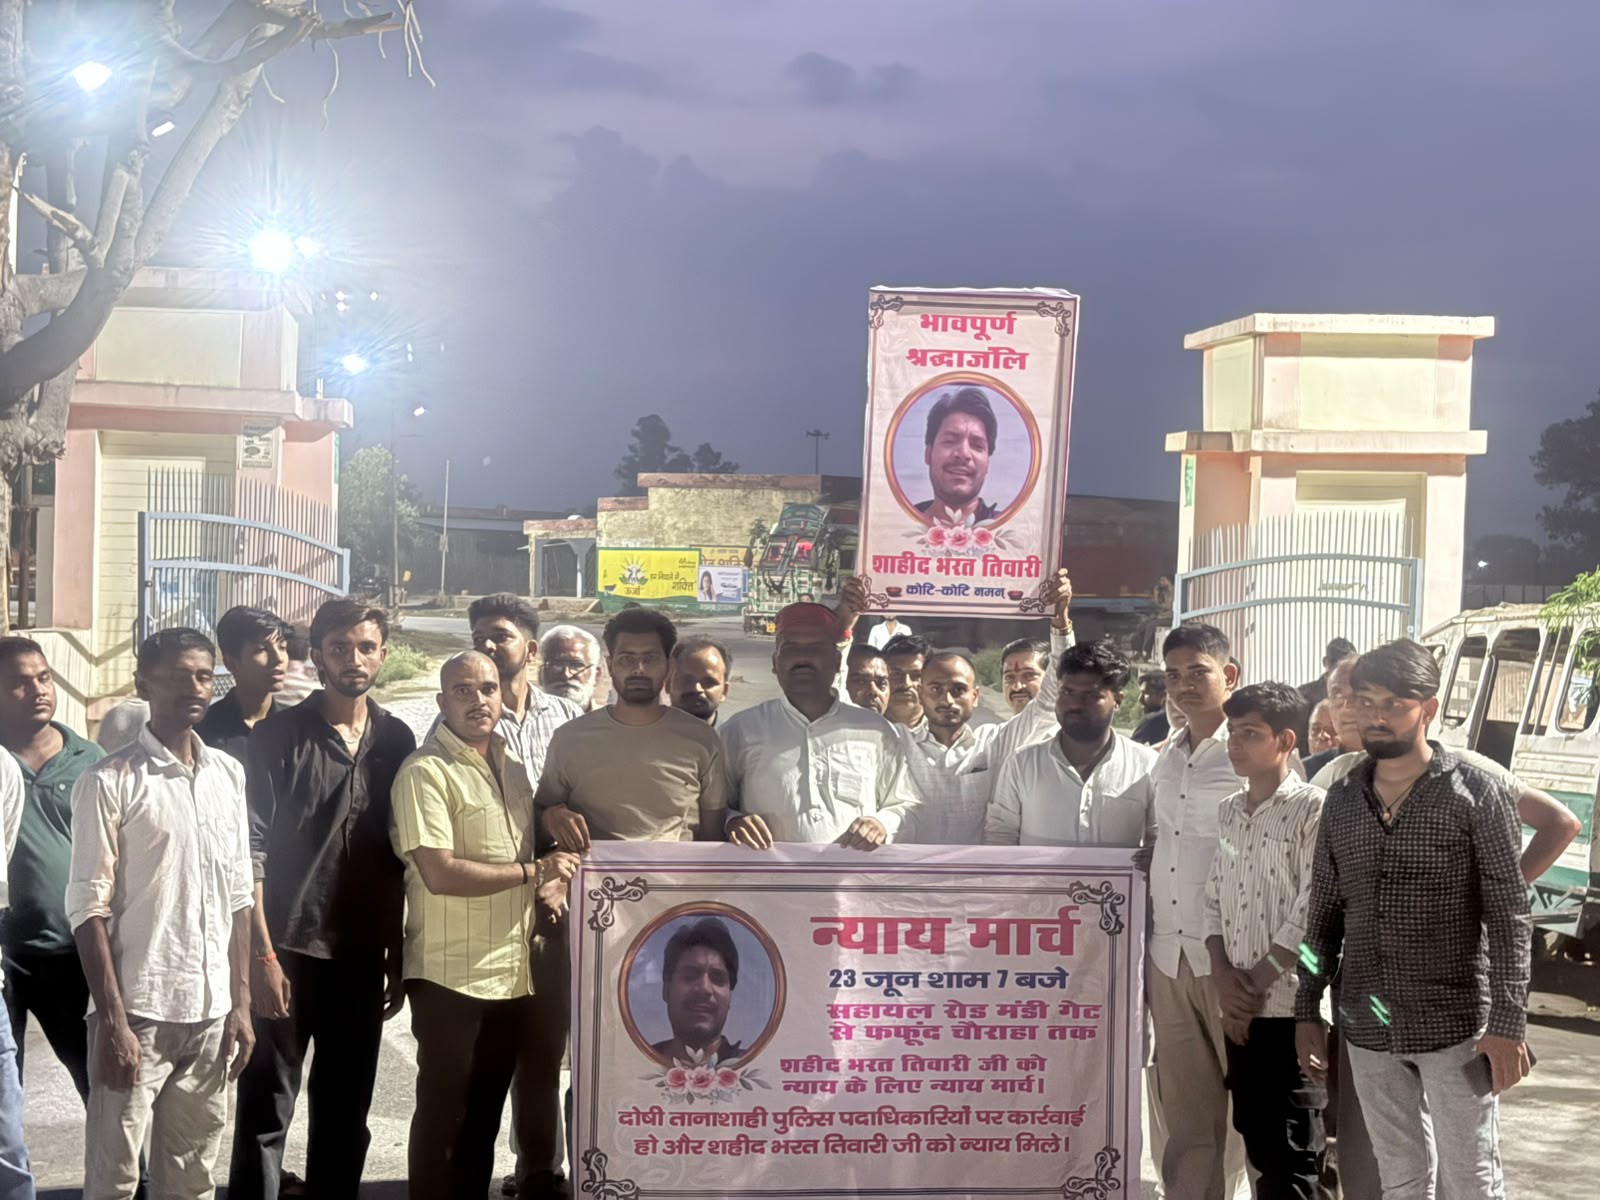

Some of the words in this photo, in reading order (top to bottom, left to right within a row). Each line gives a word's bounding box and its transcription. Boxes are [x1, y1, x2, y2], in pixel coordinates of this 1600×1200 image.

[920, 311, 1017, 341] भावपूर्ण
[872, 550, 932, 575] शाहीद
[936, 557, 977, 577] भरत
[982, 553, 1042, 578] तिवारी
[906, 582, 970, 597] कोटि-कोटि
[809, 916, 952, 956] न्याय
[967, 905, 1082, 956] मार्च
[829, 968, 856, 988] 23
[862, 970, 921, 997] जून
[927, 971, 991, 989] शाम
[996, 969, 1009, 988] 7
[1015, 965, 1069, 990] बजे
[827, 1003, 935, 1019] सहायल
[943, 999, 989, 1019] रोड
[996, 999, 1050, 1019] मंडी
[1058, 1000, 1103, 1020] गेट
[829, 1021, 855, 1041] से
[861, 1021, 943, 1046] फफूंद
[951, 1021, 1039, 1041] चौराहा
[1046, 1025, 1098, 1041] तक
[780, 1054, 842, 1073] शहीद
[847, 1057, 895, 1072] भरत
[901, 1054, 971, 1072] तिवारी
[978, 1054, 1010, 1072] जी
[1016, 1053, 1048, 1072] को
[782, 1080, 839, 1095] न्याय
[845, 1076, 868, 1094] के
[875, 1076, 923, 1094] लिए
[930, 1079, 985, 1093] न्याय
[618, 1105, 665, 1127] दोषी
[669, 1105, 769, 1128] तानाशाही
[772, 1105, 836, 1135] पुलिस
[839, 1105, 971, 1126] पदाधिकारियों
[975, 1109, 1006, 1125] पर
[1007, 1104, 1087, 1127] कार्रवाई
[634, 1133, 659, 1156] हो
[662, 1132, 706, 1155] और
[708, 1133, 768, 1156] शहीद
[771, 1139, 821, 1155] भरत
[823, 1132, 889, 1154] तिवारी
[892, 1132, 922, 1153] जी
[925, 1133, 957, 1153] को
[959, 1137, 1011, 1153] न्याय
